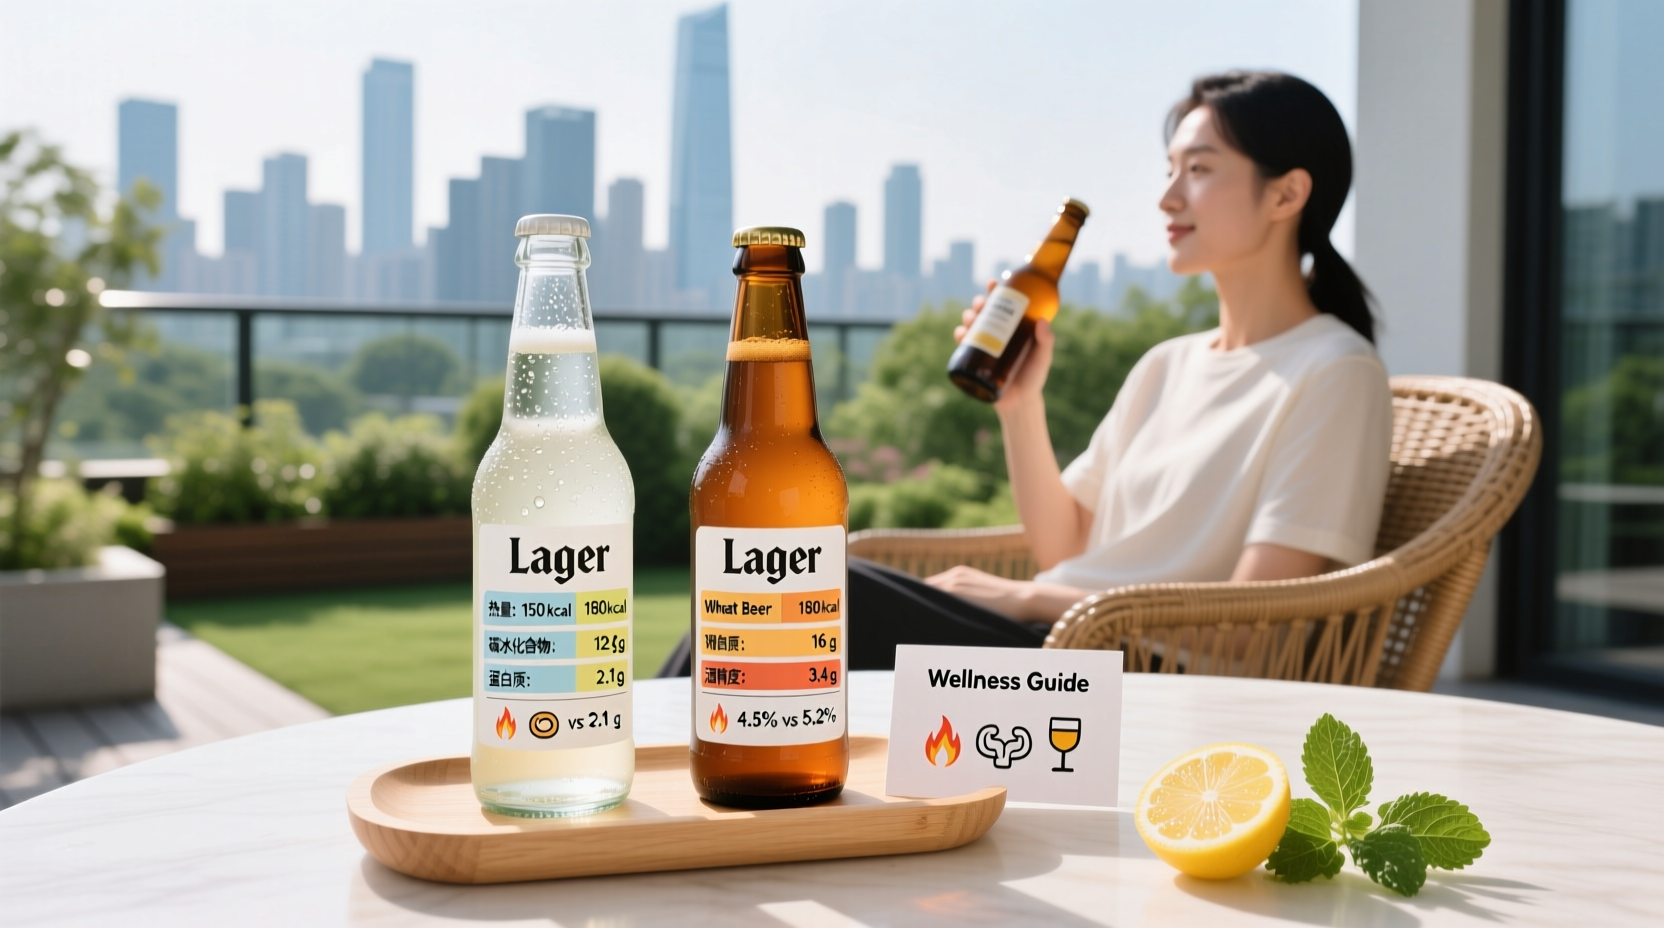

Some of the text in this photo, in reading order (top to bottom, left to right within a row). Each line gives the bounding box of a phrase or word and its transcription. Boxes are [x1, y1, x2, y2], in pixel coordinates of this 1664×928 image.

[509, 537, 610, 585] Lager
[723, 538, 822, 585] Lager
[742, 601, 772, 616] Beer
[928, 669, 1090, 692] Wellness Guide
[568, 718, 585, 730] vs
[588, 710, 608, 728] 2.1
[737, 706, 837, 728] 4.5% vs 5.2%
